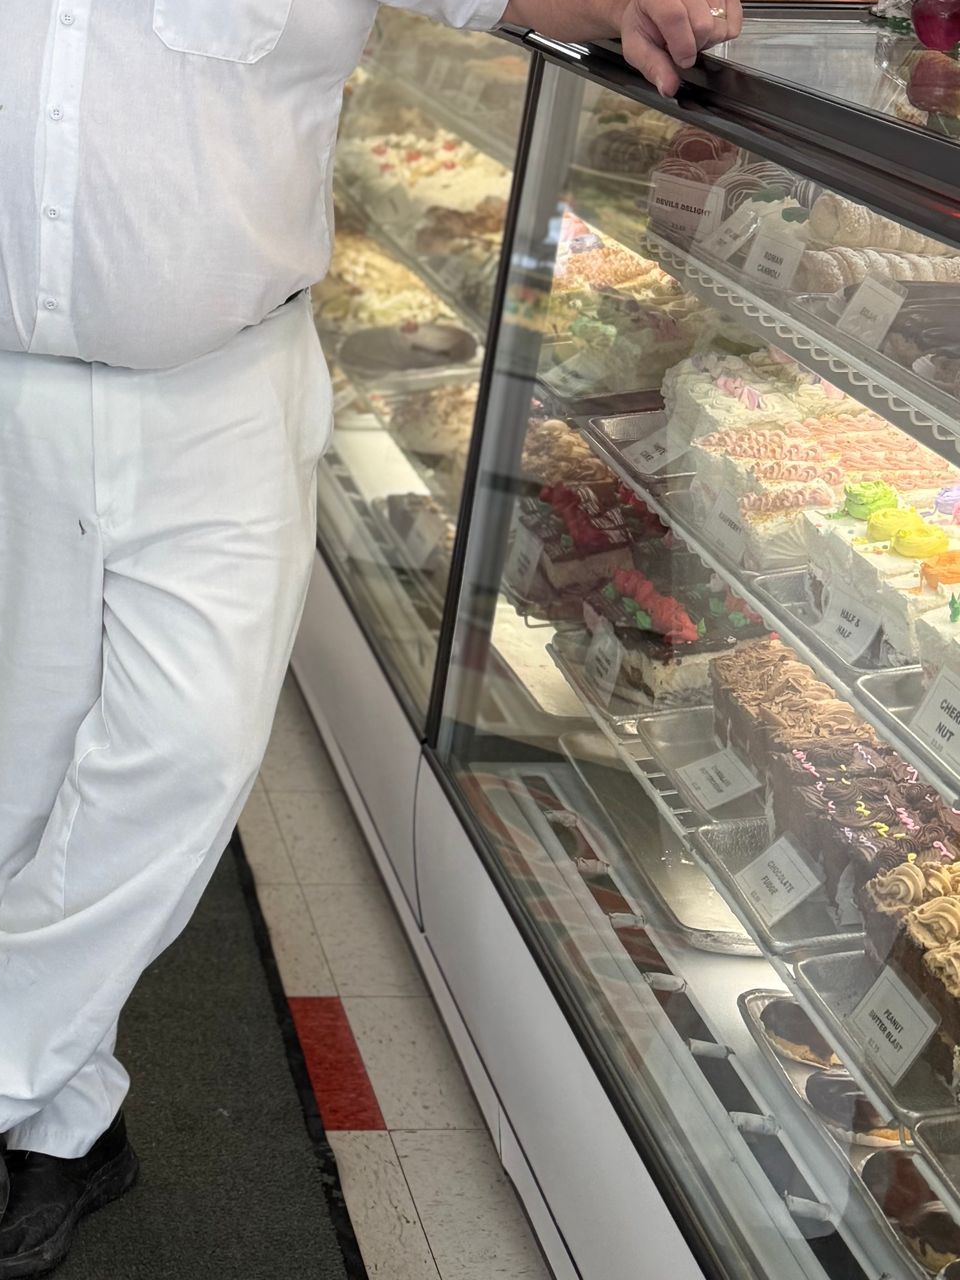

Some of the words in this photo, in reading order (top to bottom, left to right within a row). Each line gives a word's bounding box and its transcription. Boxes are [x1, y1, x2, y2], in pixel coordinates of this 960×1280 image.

[655, 196, 680, 210] DEVILS
[680, 202, 712, 218] DELIGHT
[840, 607, 855, 625] HALF
[837, 624, 852, 639] HALF
[935, 721, 955, 742] NUT
[760, 875, 778, 896] FUDGE
[767, 860, 795, 894] CHOCOLATE
[868, 1008, 887, 1035] BUTTER
[885, 1030, 903, 1053] BLAST
[883, 1008, 904, 1034] PEANUT
